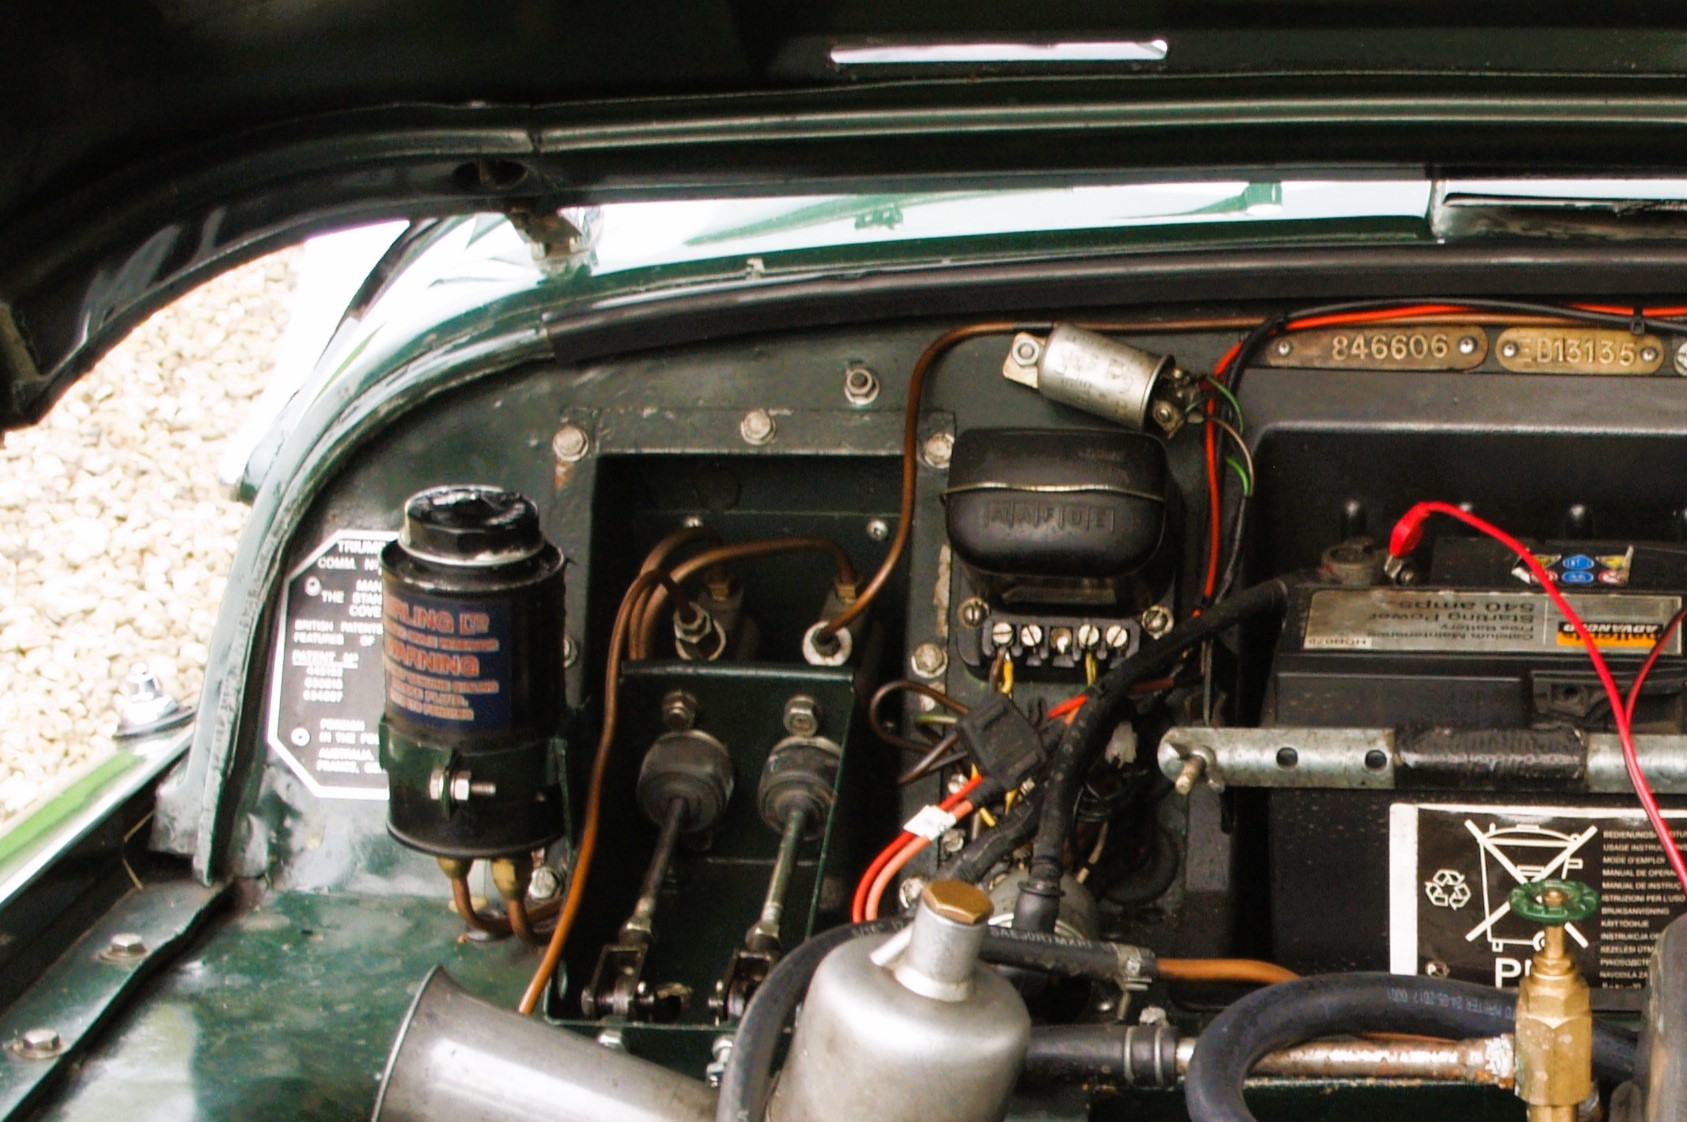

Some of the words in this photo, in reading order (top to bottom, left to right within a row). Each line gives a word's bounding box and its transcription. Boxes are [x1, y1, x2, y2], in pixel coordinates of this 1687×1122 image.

[1331, 333, 1449, 361] 846606
[321, 590, 344, 603] THE
[1484, 602, 1535, 612] 540
[1368, 612, 1439, 623] Power
[1446, 611, 1535, 623] Starting
[1440, 622, 1498, 633] Battery
[1562, 623, 1659, 634] ADVANCD
[1602, 856, 1627, 864] MODE
[1602, 868, 1634, 877] MANUAL
[1635, 868, 1647, 877] DE
[1602, 881, 1633, 889] MANUAL
